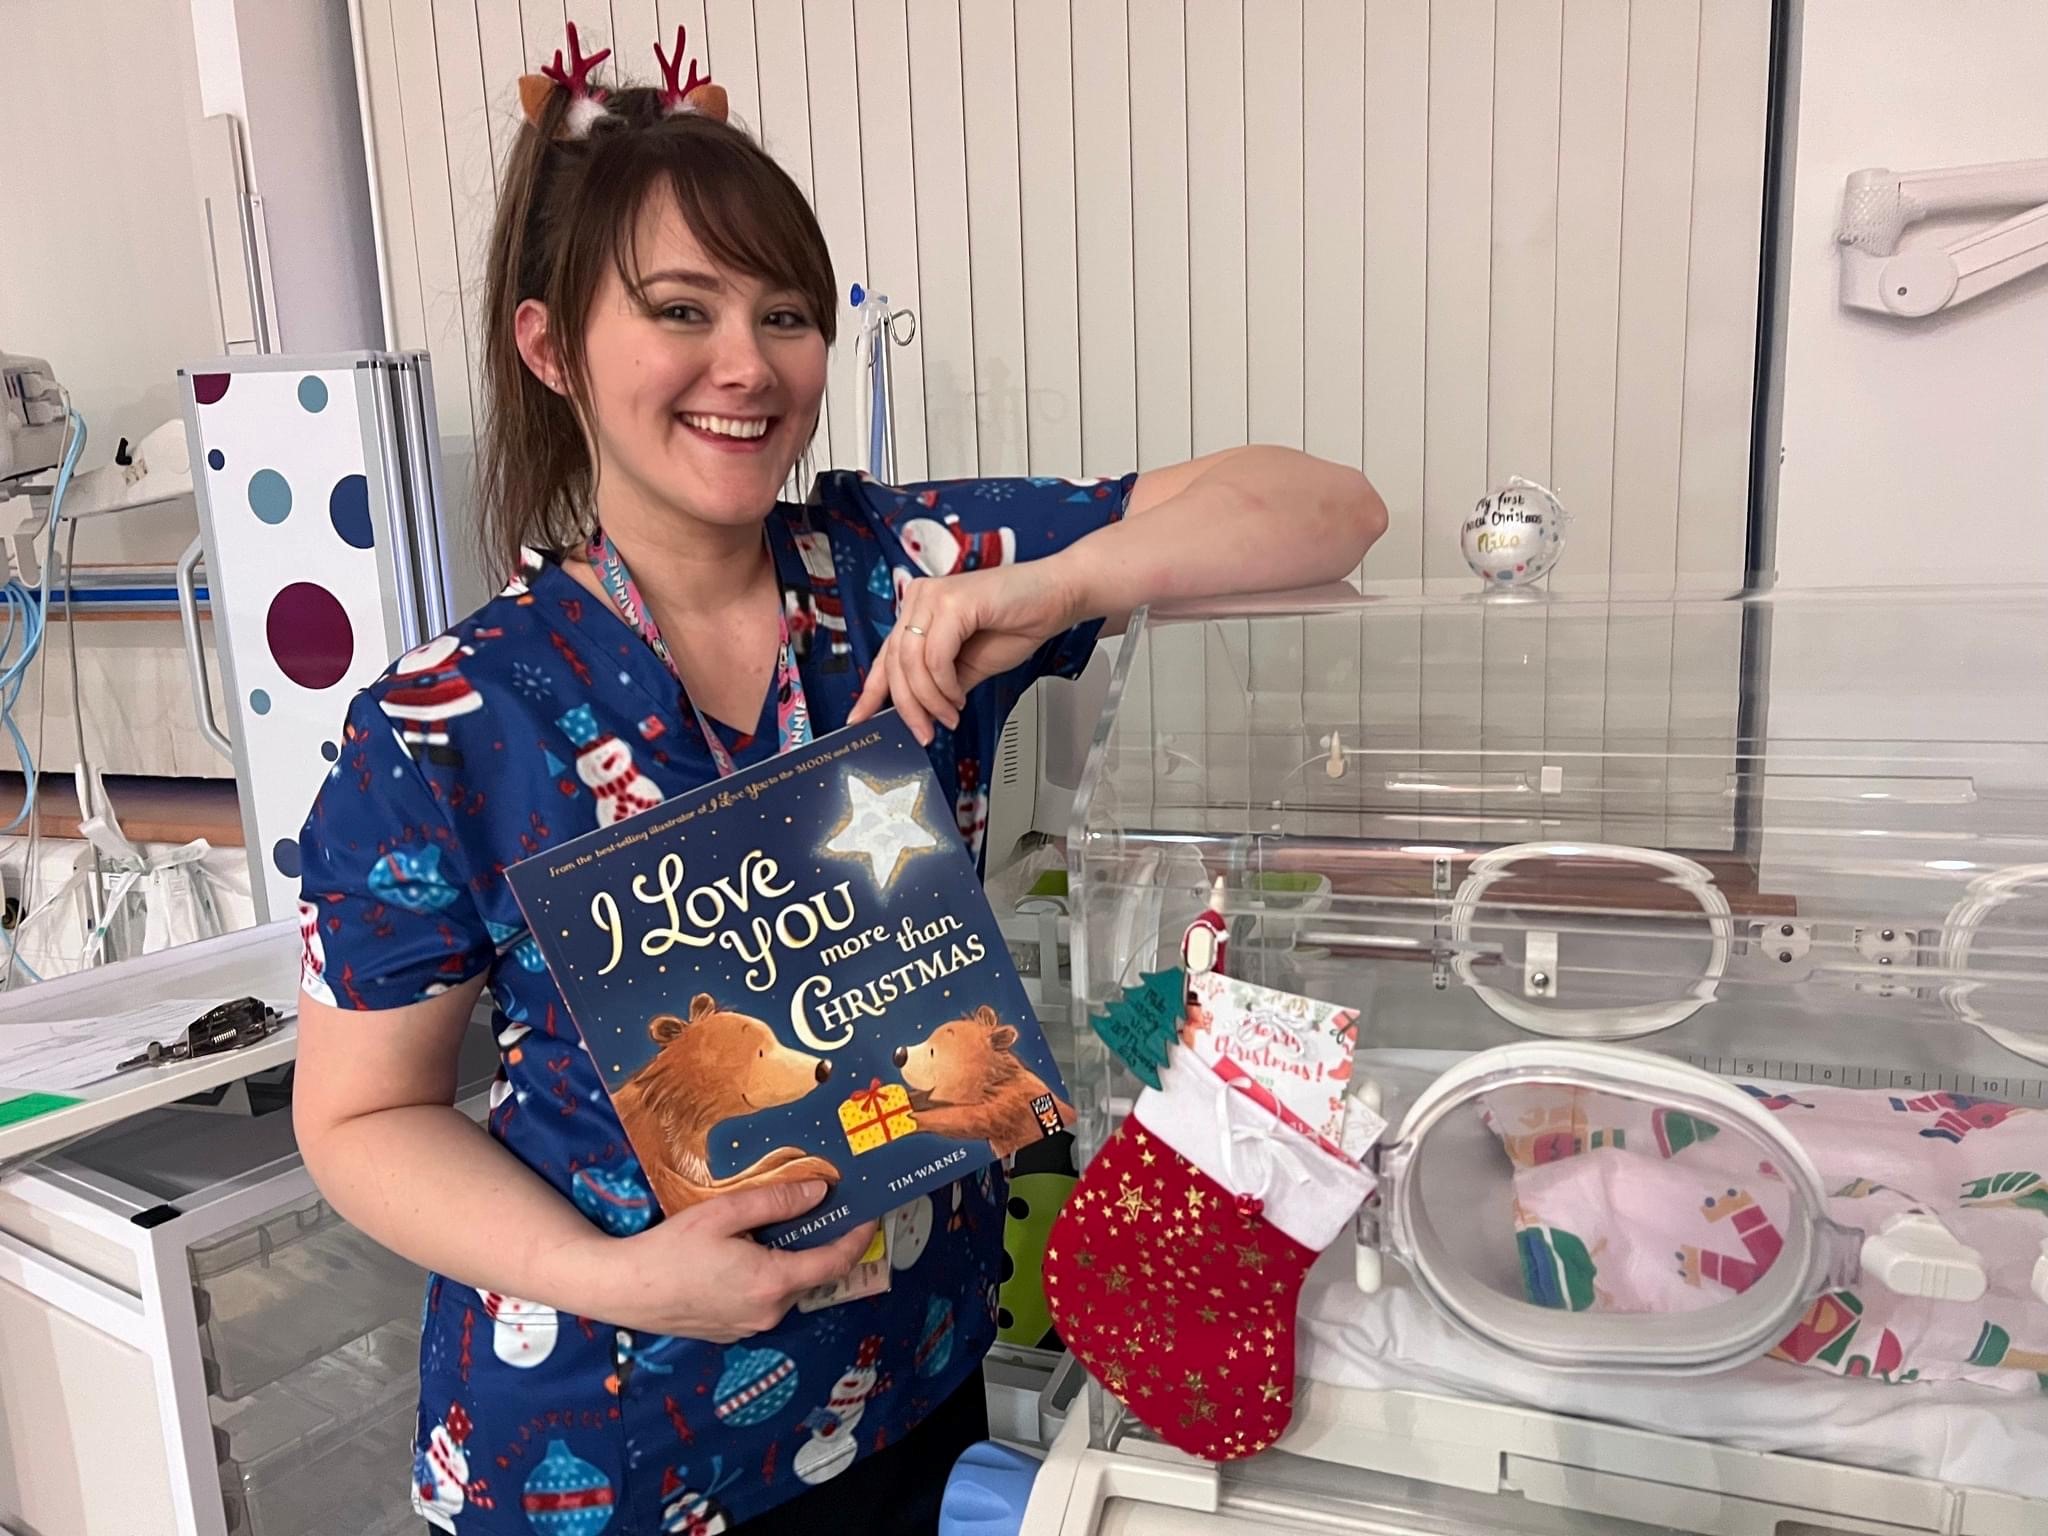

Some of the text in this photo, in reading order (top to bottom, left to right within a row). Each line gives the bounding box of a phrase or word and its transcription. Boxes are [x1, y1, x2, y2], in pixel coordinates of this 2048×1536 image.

[607, 556, 639, 626] MINNIE
[790, 698, 806, 751] INNIE
[549, 861, 576, 878] From
[576, 853, 593, 867] the
[595, 831, 649, 858] best-selling
[649, 810, 696, 835] illustrator
[697, 804, 708, 815] of
[768, 776, 779, 786] to
[779, 769, 795, 781] the
[795, 751, 834, 774] MOON
[833, 745, 850, 759] and
[850, 731, 882, 751] BACK
[591, 893, 624, 976] I
[820, 912, 964, 967] more than
[1745, 1063, 1998, 1092] 5 0 5 10
[888, 1147, 968, 1193] TIM WARNES
[799, 1204, 851, 1236] HATTIE
